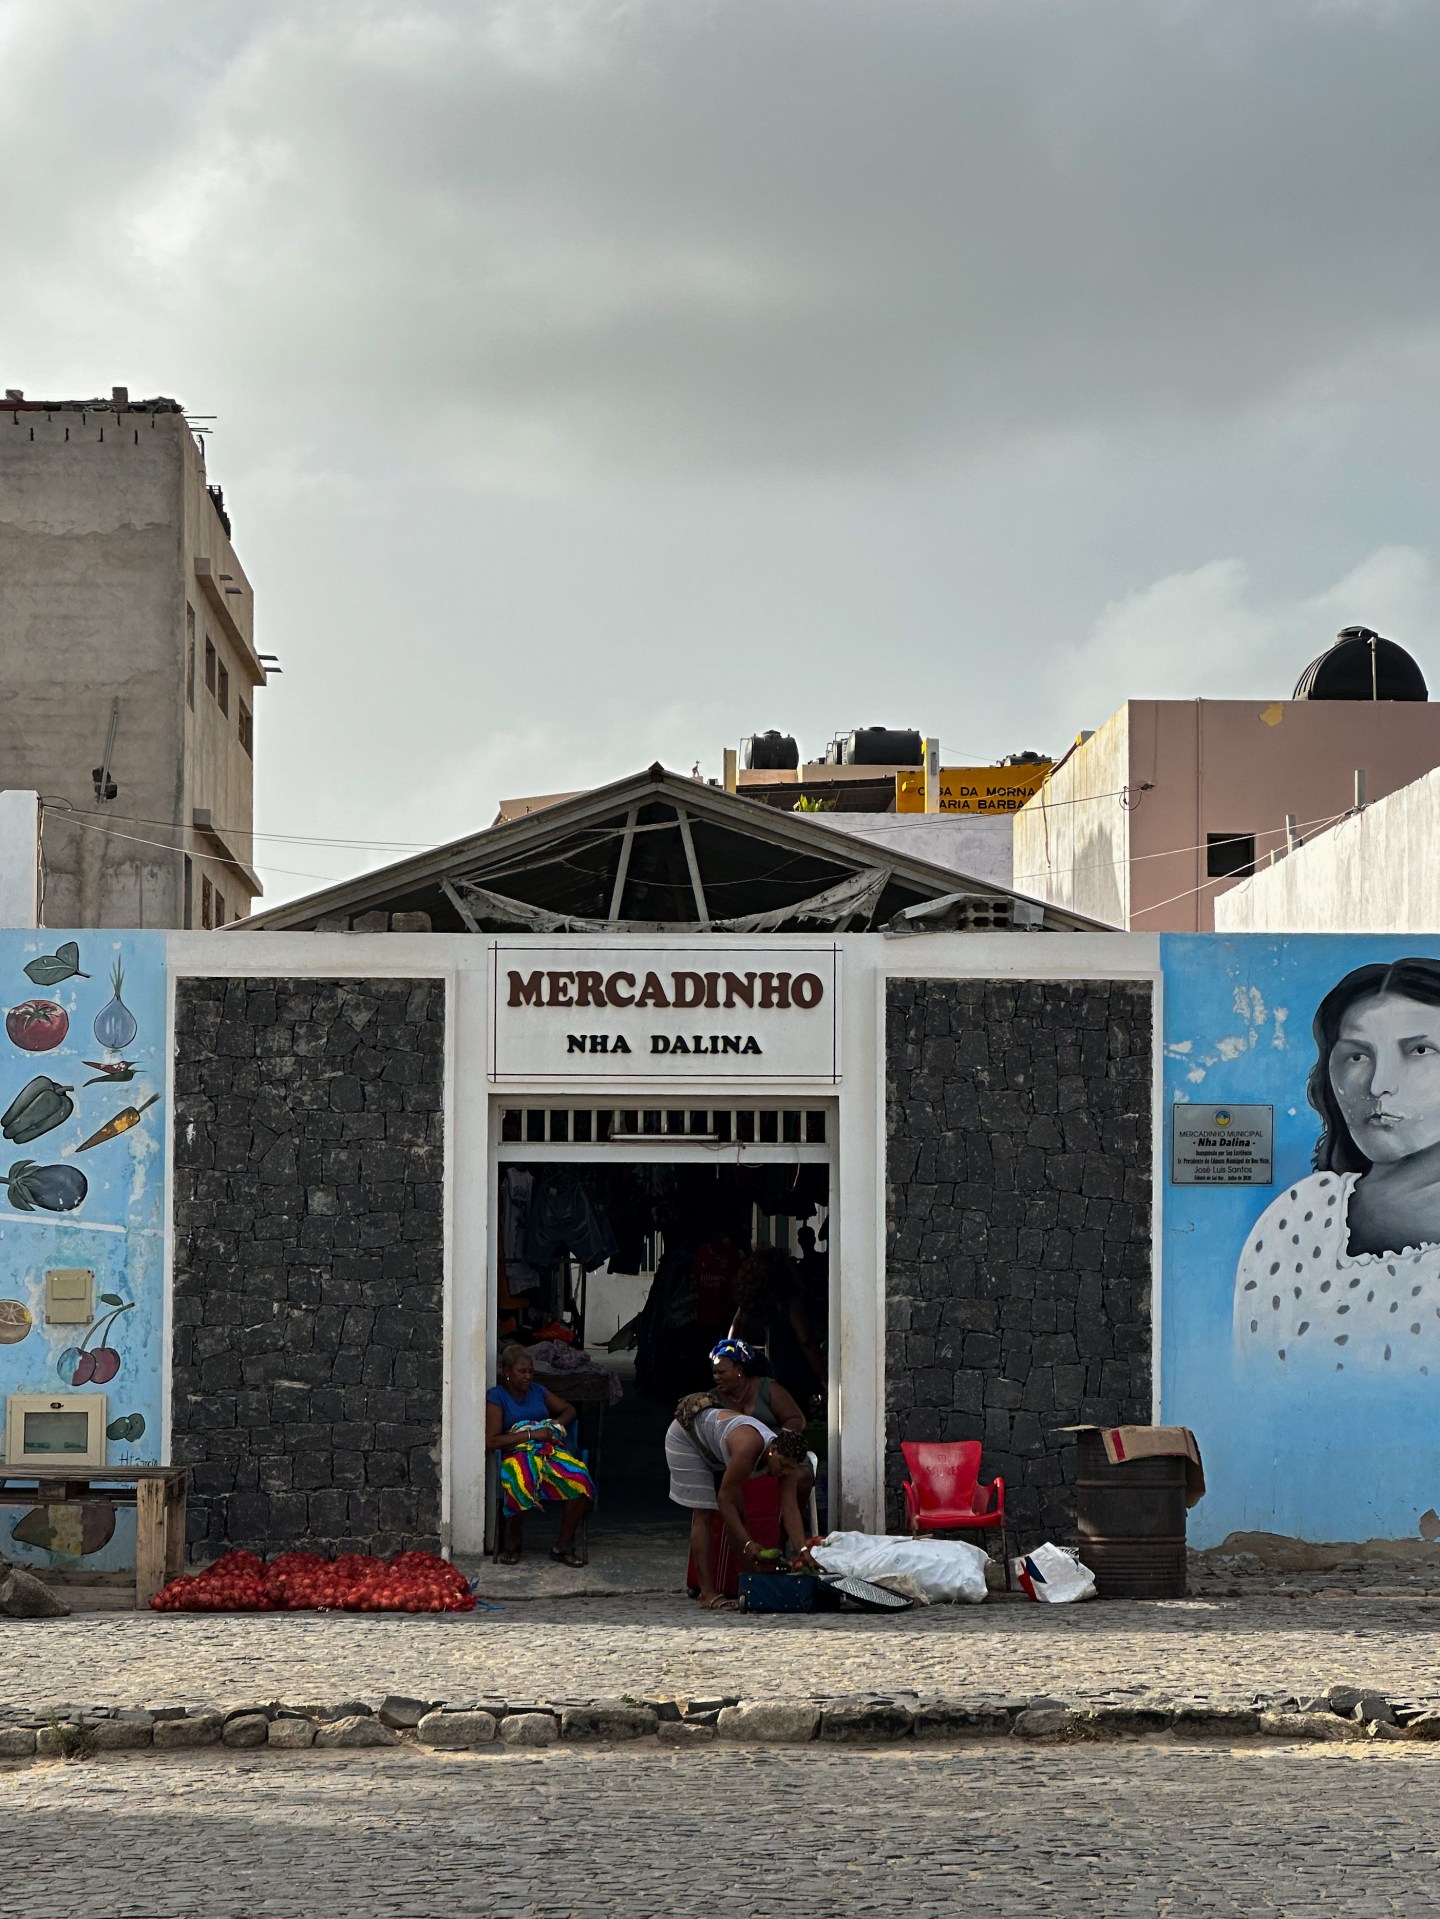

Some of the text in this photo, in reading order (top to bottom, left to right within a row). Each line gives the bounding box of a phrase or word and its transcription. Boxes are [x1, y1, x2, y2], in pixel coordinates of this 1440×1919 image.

[918, 787, 1035, 796] CSA DA MORNA
[939, 800, 1024, 809] ARIA BARBA
[507, 970, 824, 1009] MERCADINHO
[566, 1034, 763, 1055] NHA DALINA
[1198, 1138, 1250, 1147] Nha Dalina
[1228, 1166, 1252, 1174] Santos
